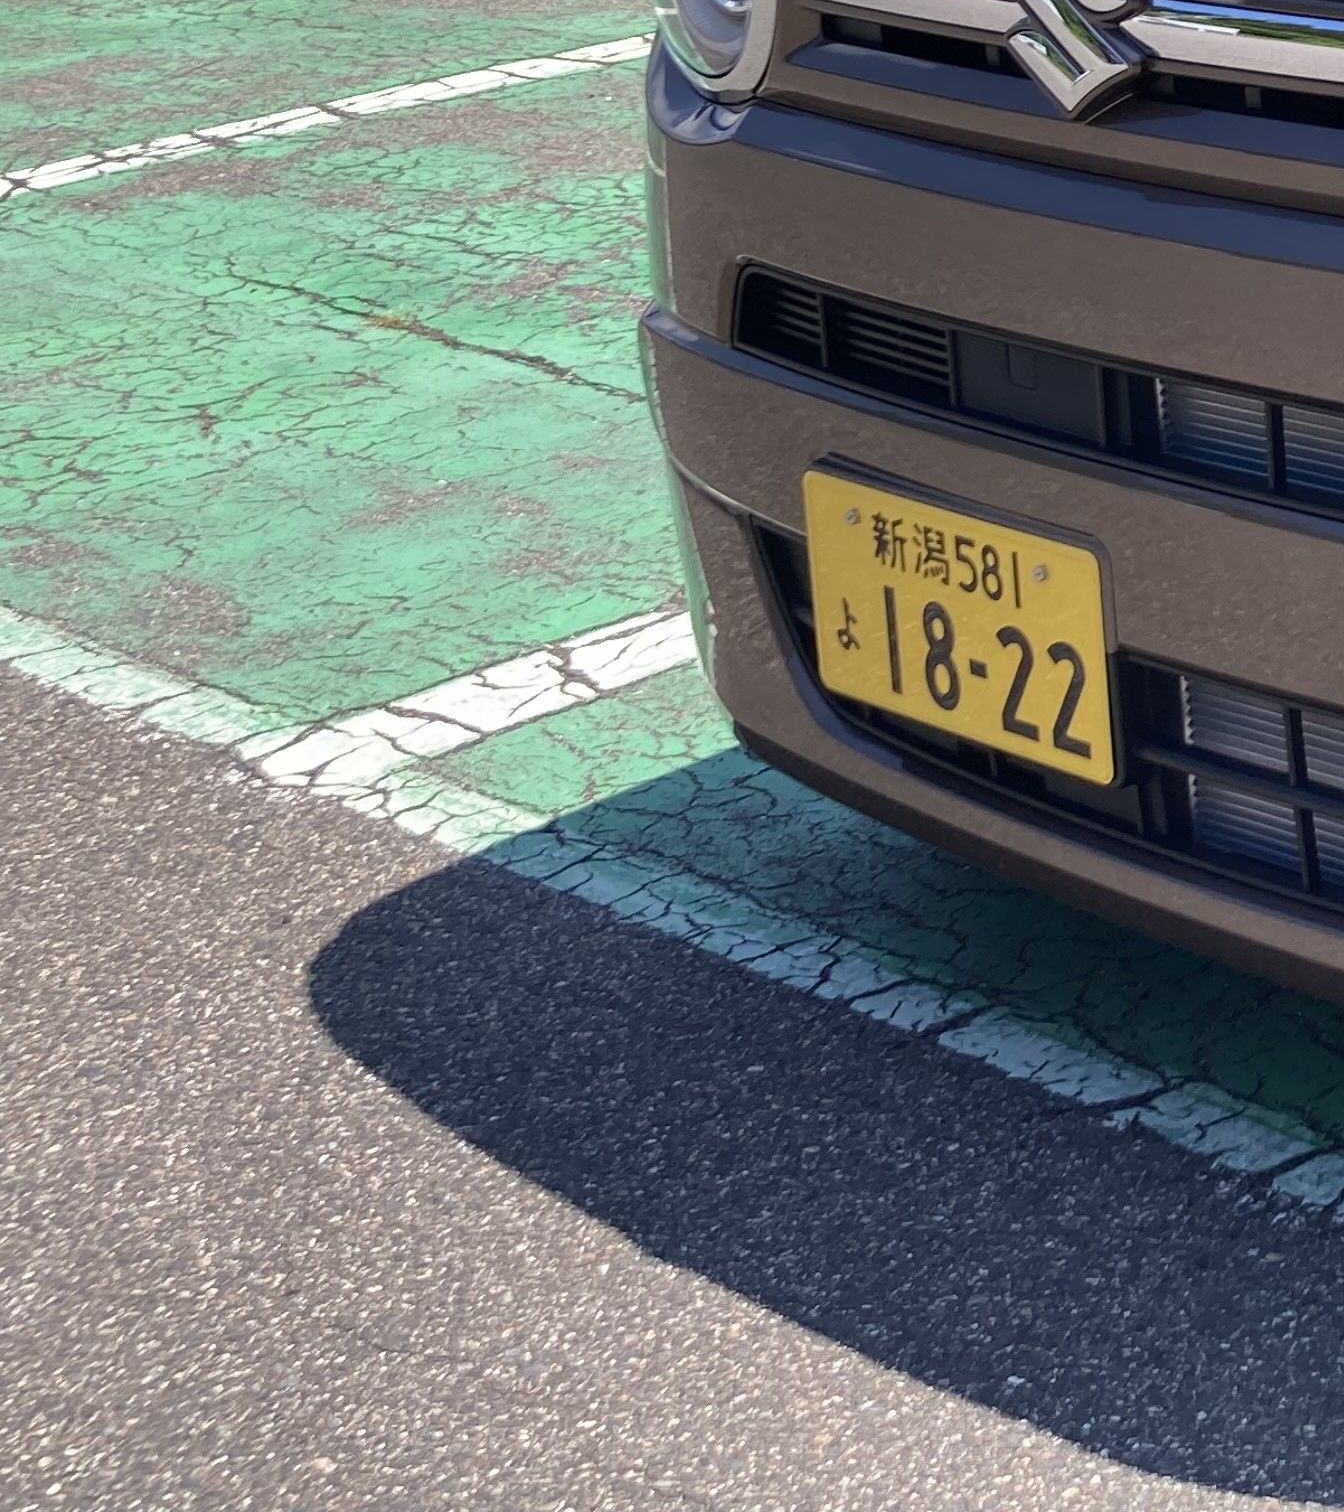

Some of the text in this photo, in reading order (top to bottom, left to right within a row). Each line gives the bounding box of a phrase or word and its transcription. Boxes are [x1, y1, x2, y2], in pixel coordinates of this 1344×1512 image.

[871, 511, 1021, 609] 新潟 581
[837, 584, 1092, 760] よ 18-22
